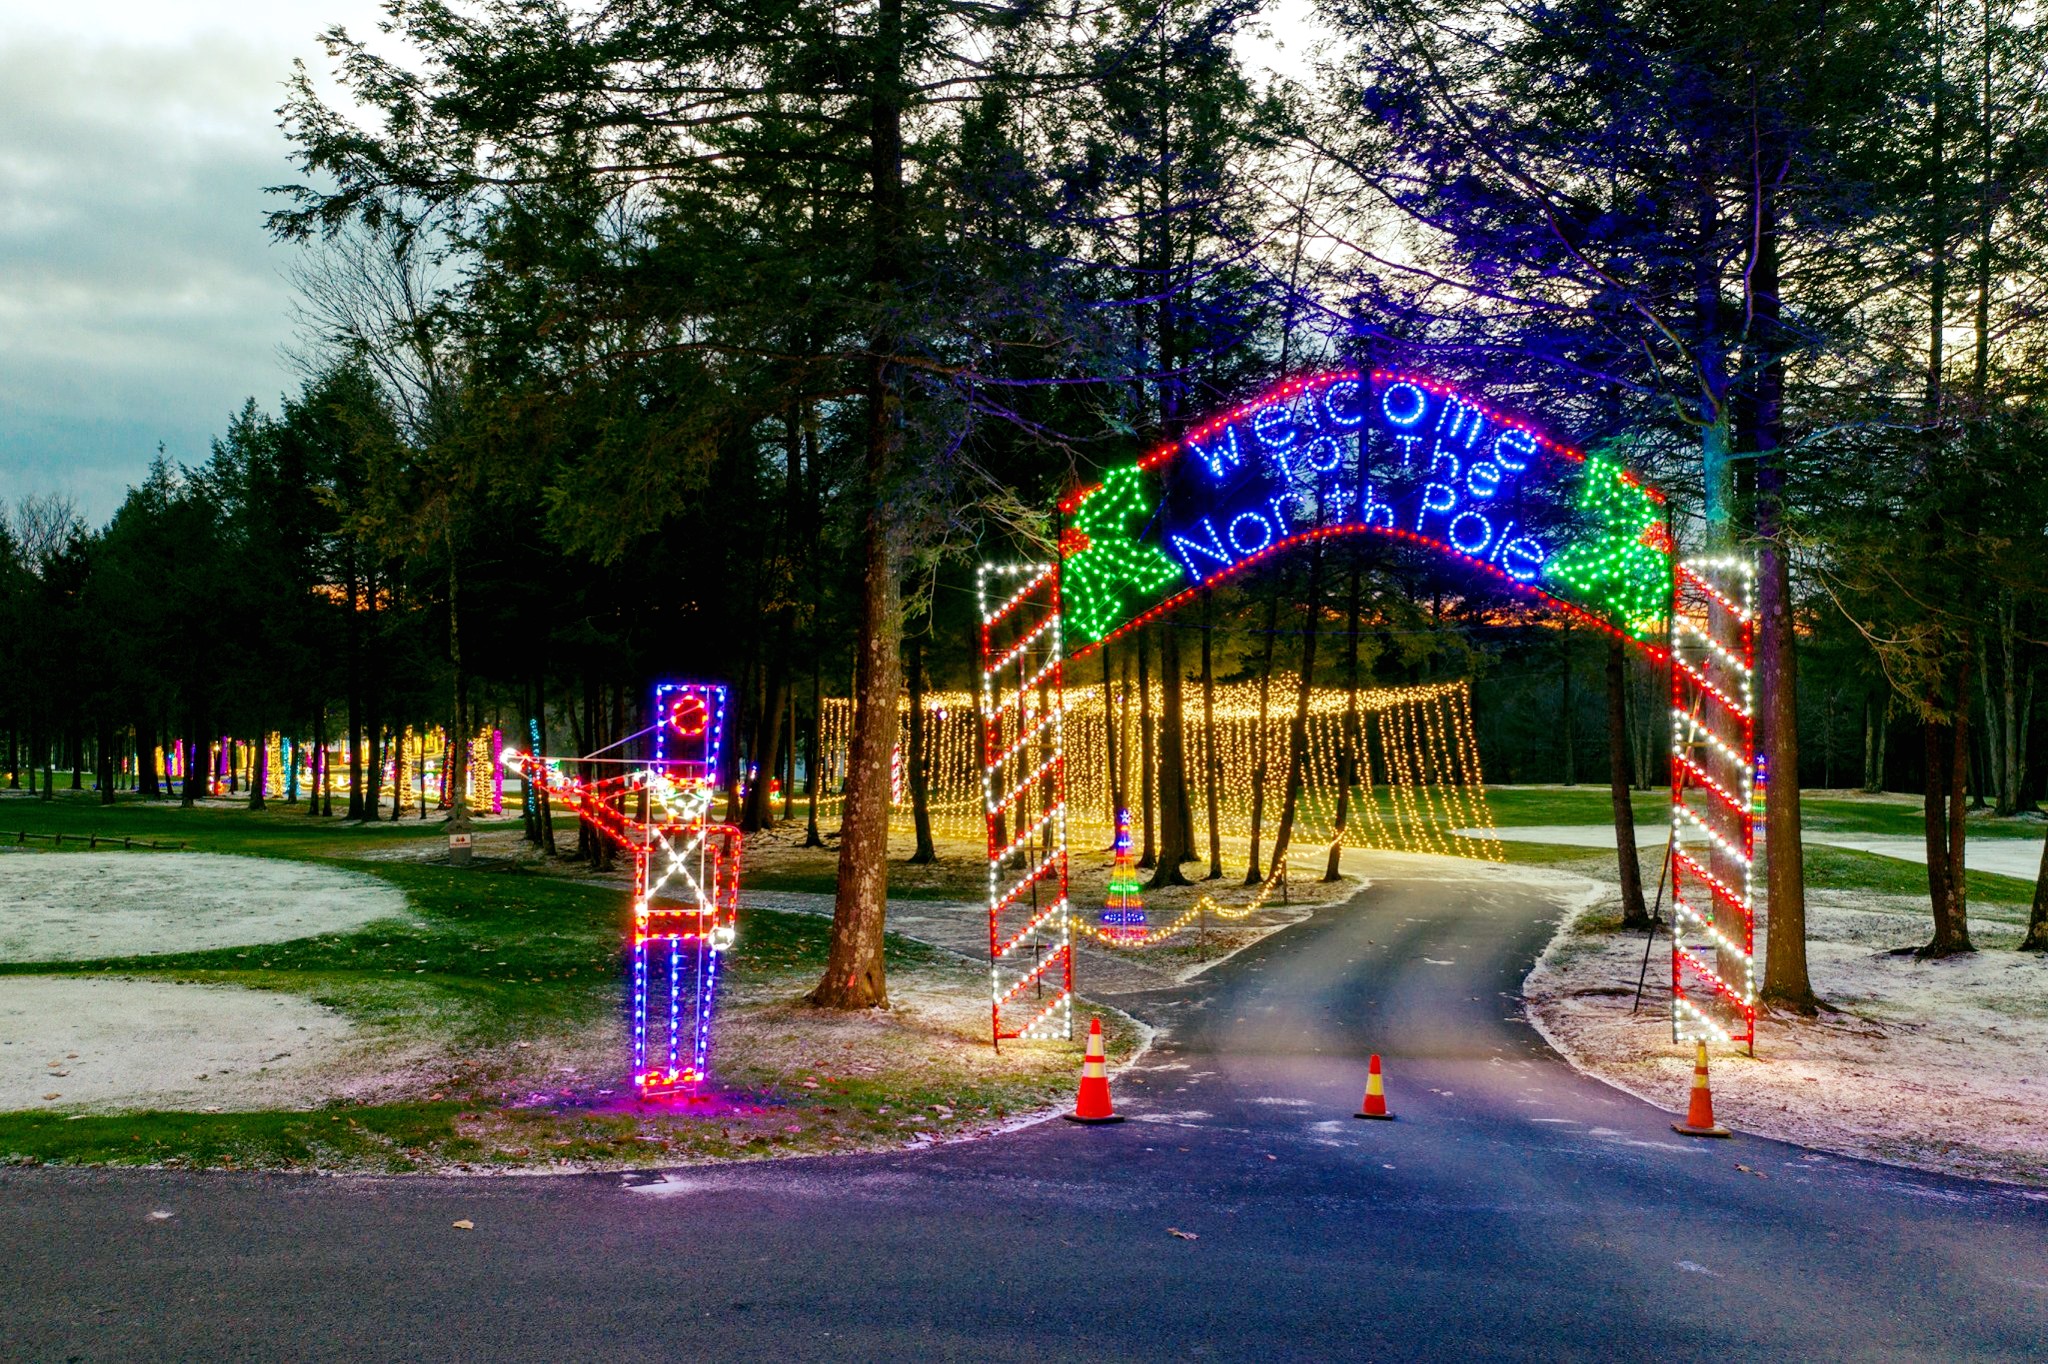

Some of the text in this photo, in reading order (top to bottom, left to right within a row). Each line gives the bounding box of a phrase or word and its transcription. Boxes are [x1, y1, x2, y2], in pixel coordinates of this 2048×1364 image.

[1271, 434, 1501, 496] To The
[1171, 481, 1545, 582] North Pole
